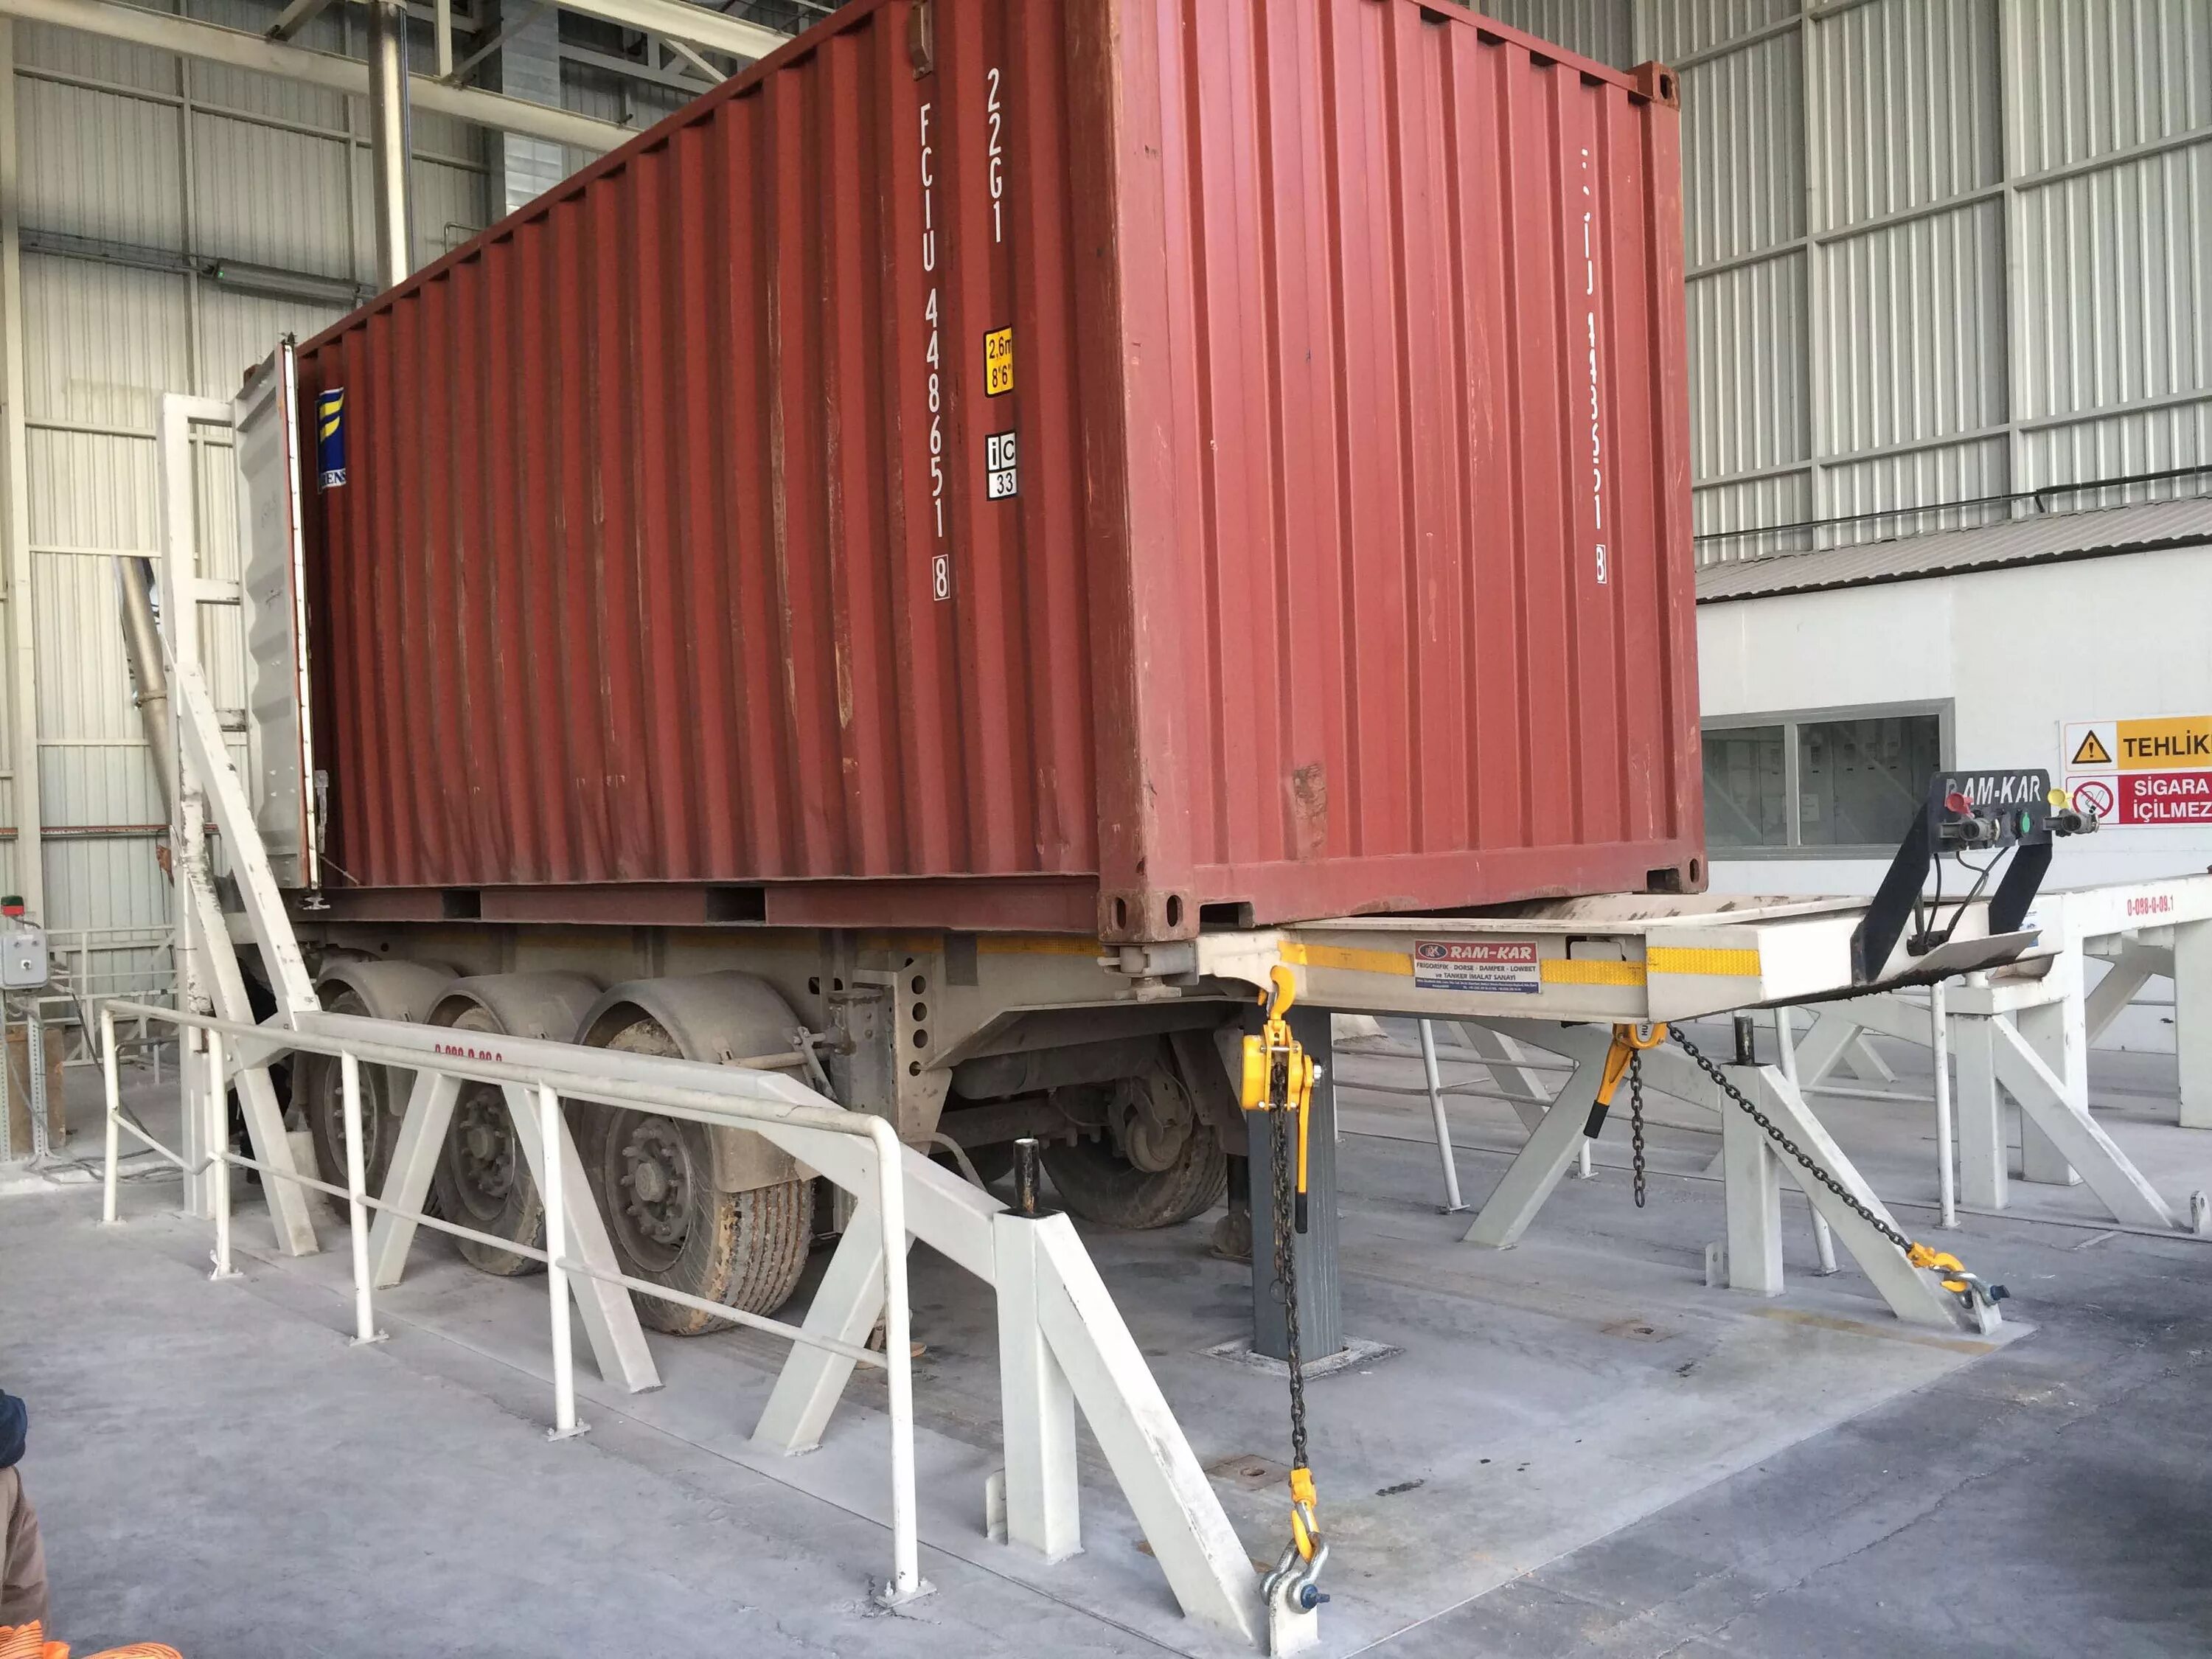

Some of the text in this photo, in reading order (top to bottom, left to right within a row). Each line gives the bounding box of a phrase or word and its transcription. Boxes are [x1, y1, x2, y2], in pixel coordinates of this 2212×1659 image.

[987, 68, 1003, 243] 22G1
[920, 103, 948, 597] FCIU 448651 8
[996, 472, 1013, 494] 33
[1596, 546, 1604, 581] 8
[2123, 729, 2212, 757] TEHLİK
[1944, 775, 2042, 808] RAM-KAR
[2134, 776, 2211, 796] SİGARA
[2133, 799, 2212, 823] İÇİLMEZ
[1450, 945, 1532, 960] RAM-KAR
